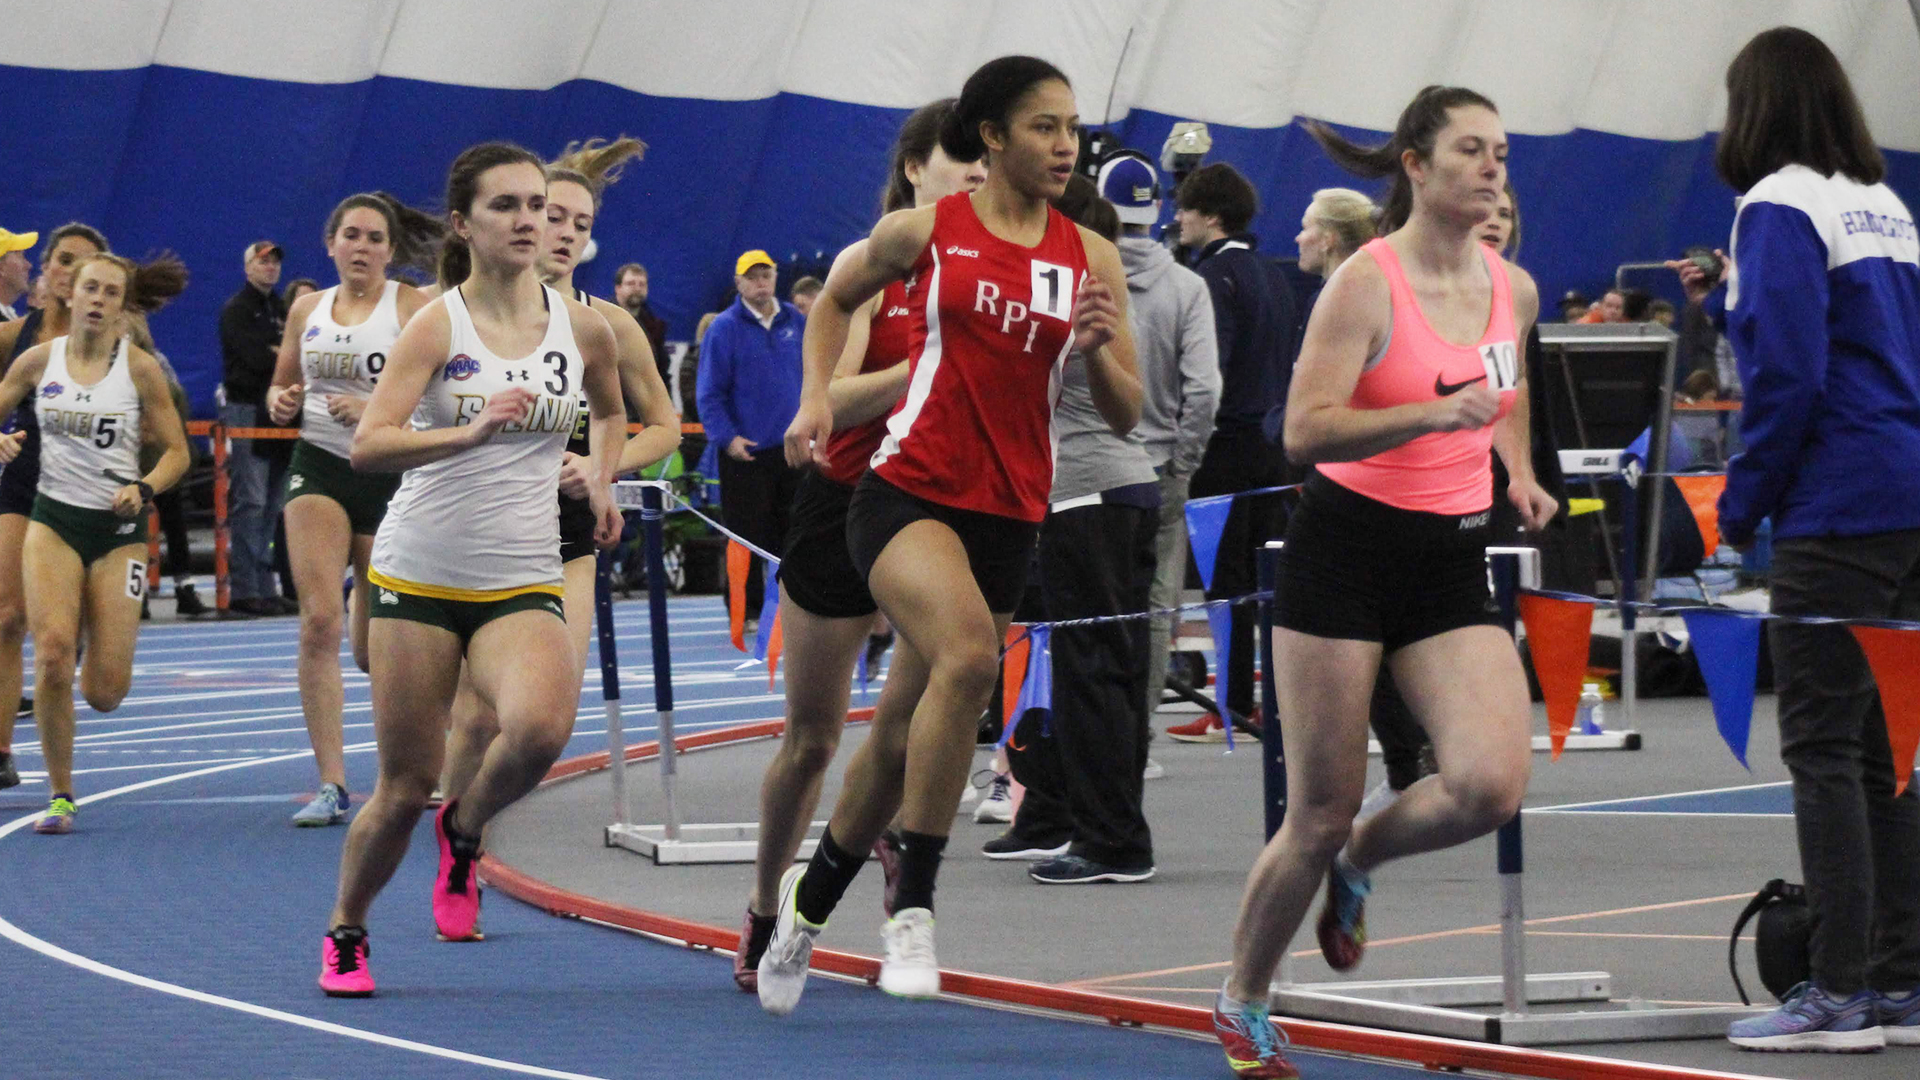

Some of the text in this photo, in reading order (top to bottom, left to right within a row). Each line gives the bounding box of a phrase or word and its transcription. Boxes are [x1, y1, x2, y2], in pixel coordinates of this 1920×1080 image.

[957, 247, 980, 258] asics
[1039, 267, 1059, 314] 1
[974, 279, 1041, 354] RPI
[366, 352, 387, 385] 9
[543, 350, 569, 397] 3
[1485, 345, 1518, 389] 10
[95, 417, 117, 449] 5
[1458, 512, 1489, 530] NIKE
[130, 563, 143, 597] 5
